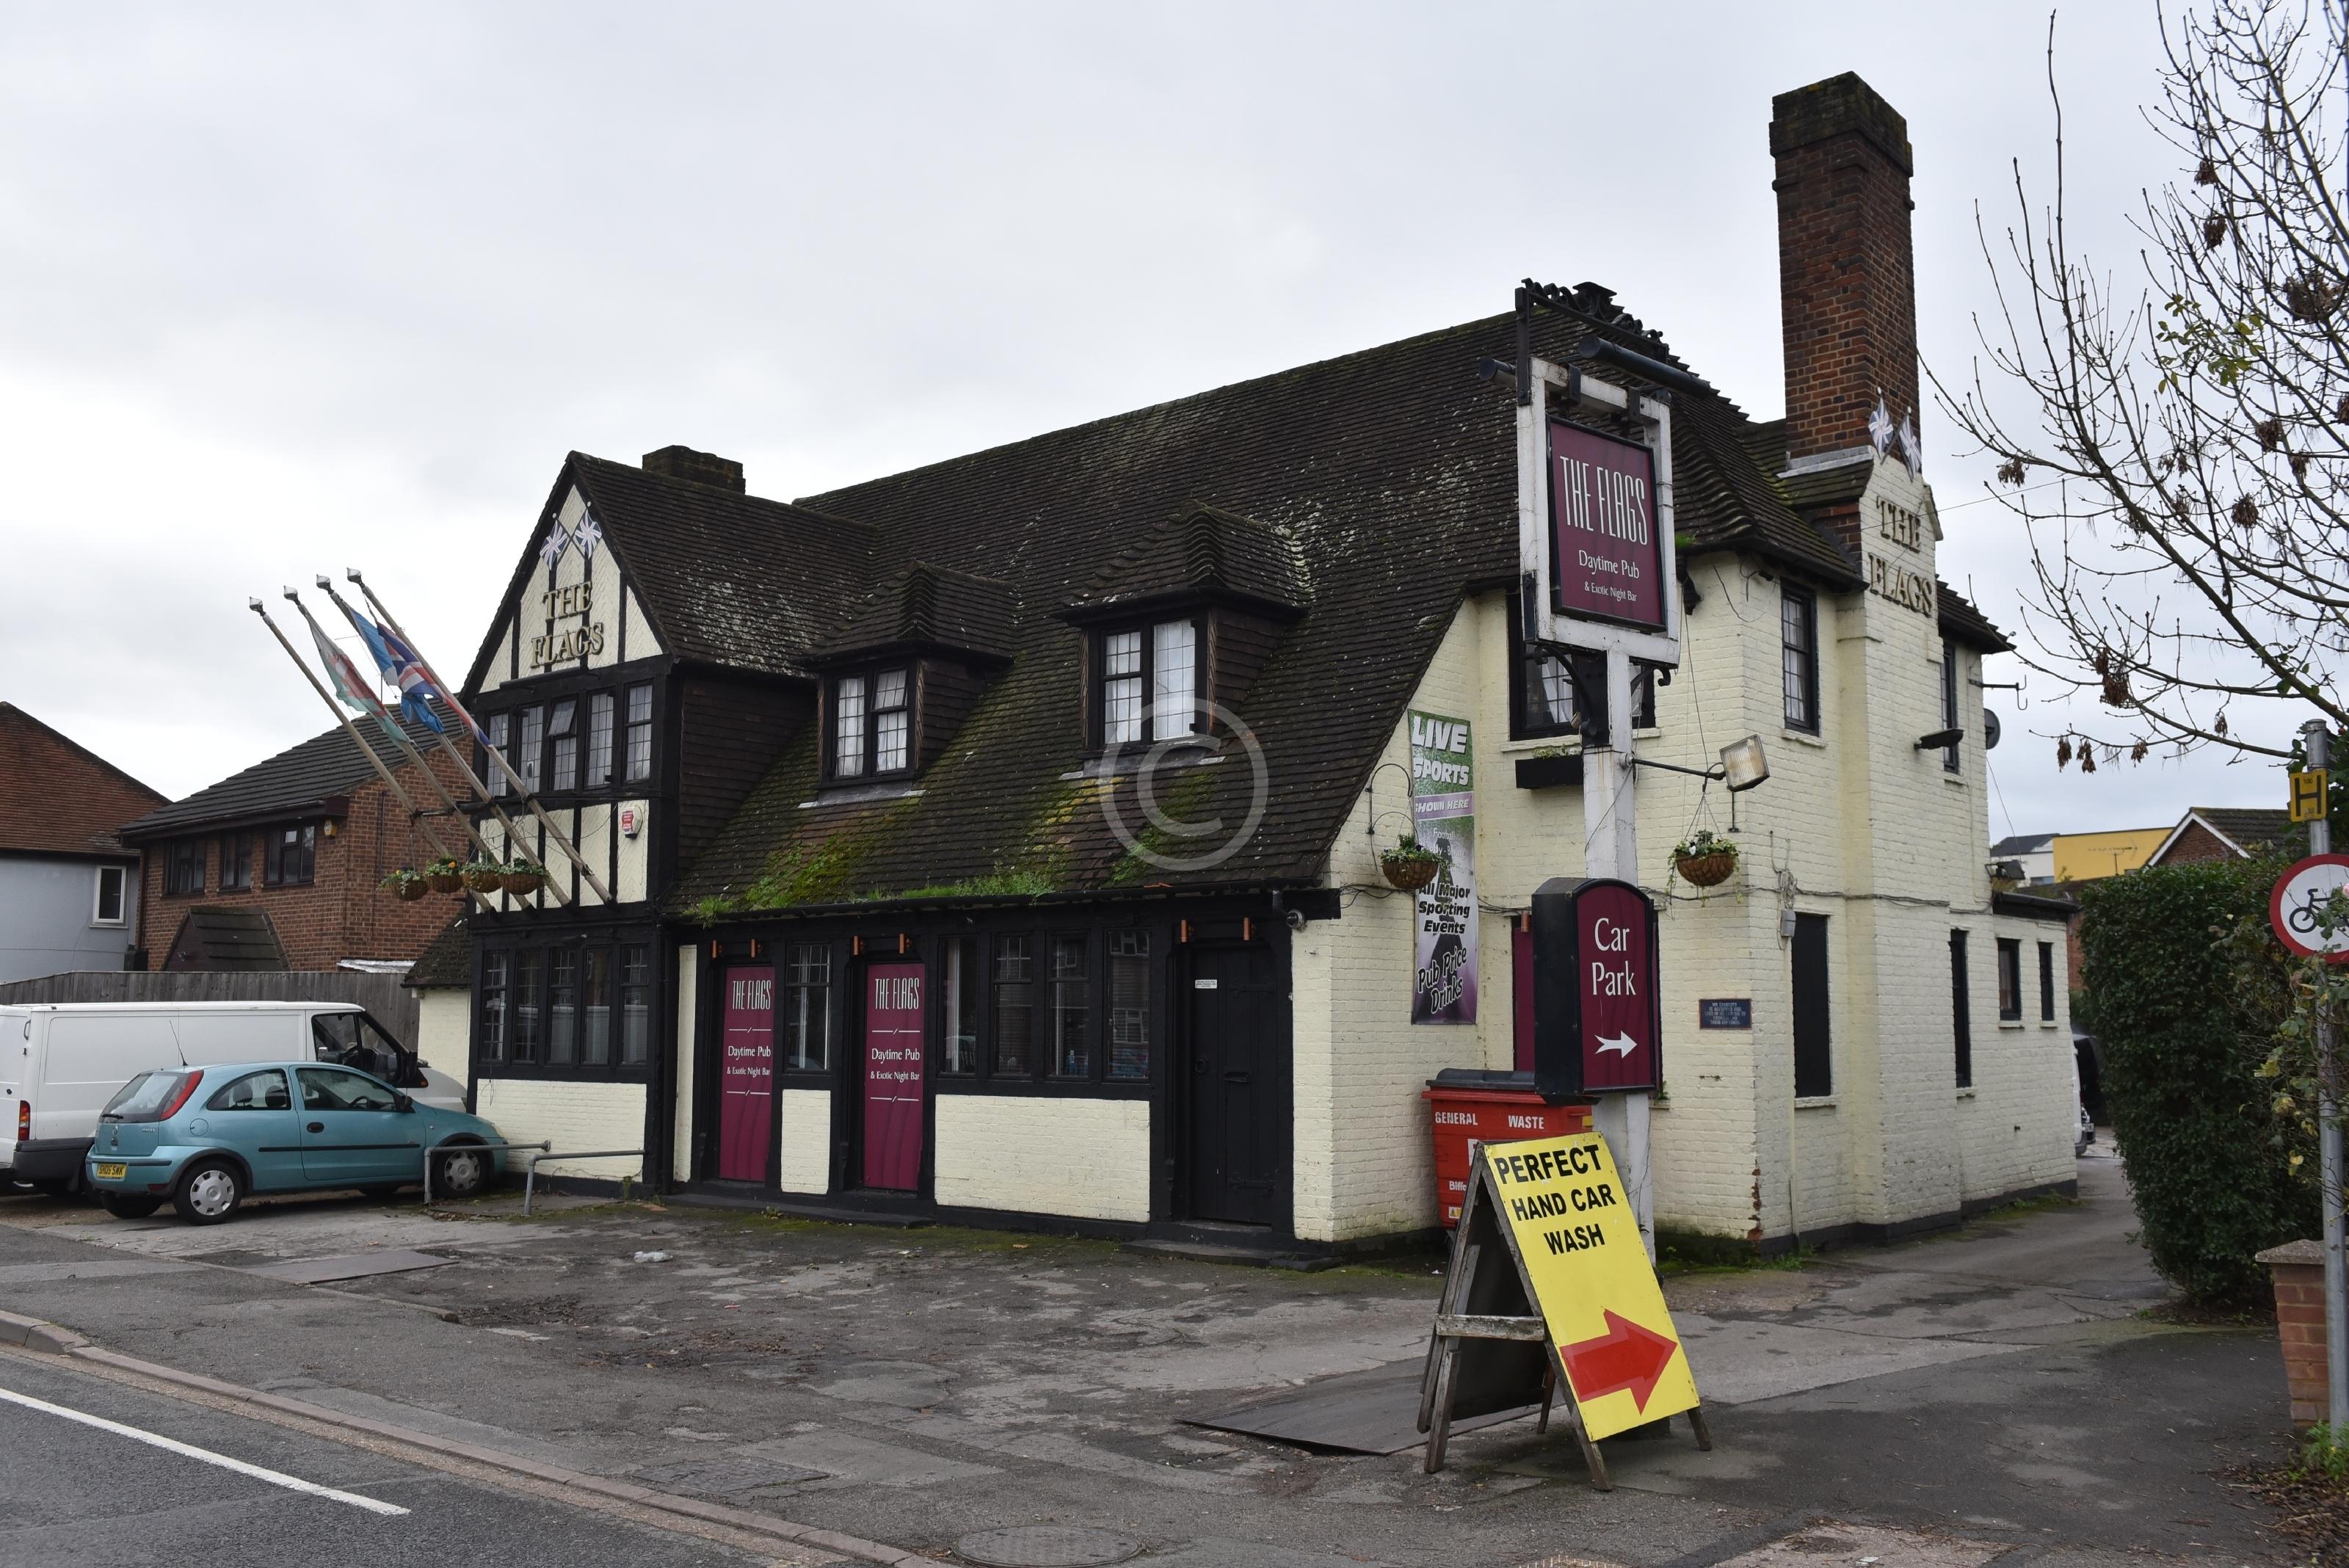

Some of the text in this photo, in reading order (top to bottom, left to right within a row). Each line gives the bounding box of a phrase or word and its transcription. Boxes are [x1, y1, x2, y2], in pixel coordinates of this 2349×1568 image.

[1560, 456, 1648, 545] THE FLAGS
[1876, 496, 1920, 553] THE
[1579, 550, 1639, 578] Daytime Pub
[1584, 581, 1637, 602] & Exotic Night Bar
[1868, 553, 1932, 618] FLAGS
[542, 581, 592, 623] THE
[530, 622, 604, 668] FLAGS
[1412, 716, 1468, 754] LIVE
[1414, 757, 1470, 785] SPORTS
[1448, 799, 1469, 810] HERE
[2295, 775, 2321, 816] H
[1434, 827, 1454, 840] Football
[1419, 883, 1470, 899] All Major
[1419, 901, 1470, 918] Sporting
[1424, 920, 1466, 934] Events
[1594, 918, 1630, 951] Car
[1417, 945, 1467, 993] Pub Price
[1591, 961, 1636, 996] Park
[732, 979, 771, 1010] THE FLAGS
[875, 978, 919, 1010] THE FLAGS
[1431, 976, 1463, 1014] Drinks
[728, 1045, 771, 1060] Daytime Pub
[871, 1048, 920, 1064] Daytime Pub
[733, 1067, 746, 1075] Exotic
[747, 1067, 760, 1076] Night
[876, 1070, 893, 1080] Exotic
[894, 1071, 910, 1084] Night
[911, 1072, 920, 1081] Bar
[1435, 1111, 1544, 1129] GENERAL WASTE
[1494, 1144, 1601, 1184] PERFECT
[1511, 1183, 1616, 1221] HAND CAR
[1543, 1223, 1605, 1255] WASH
